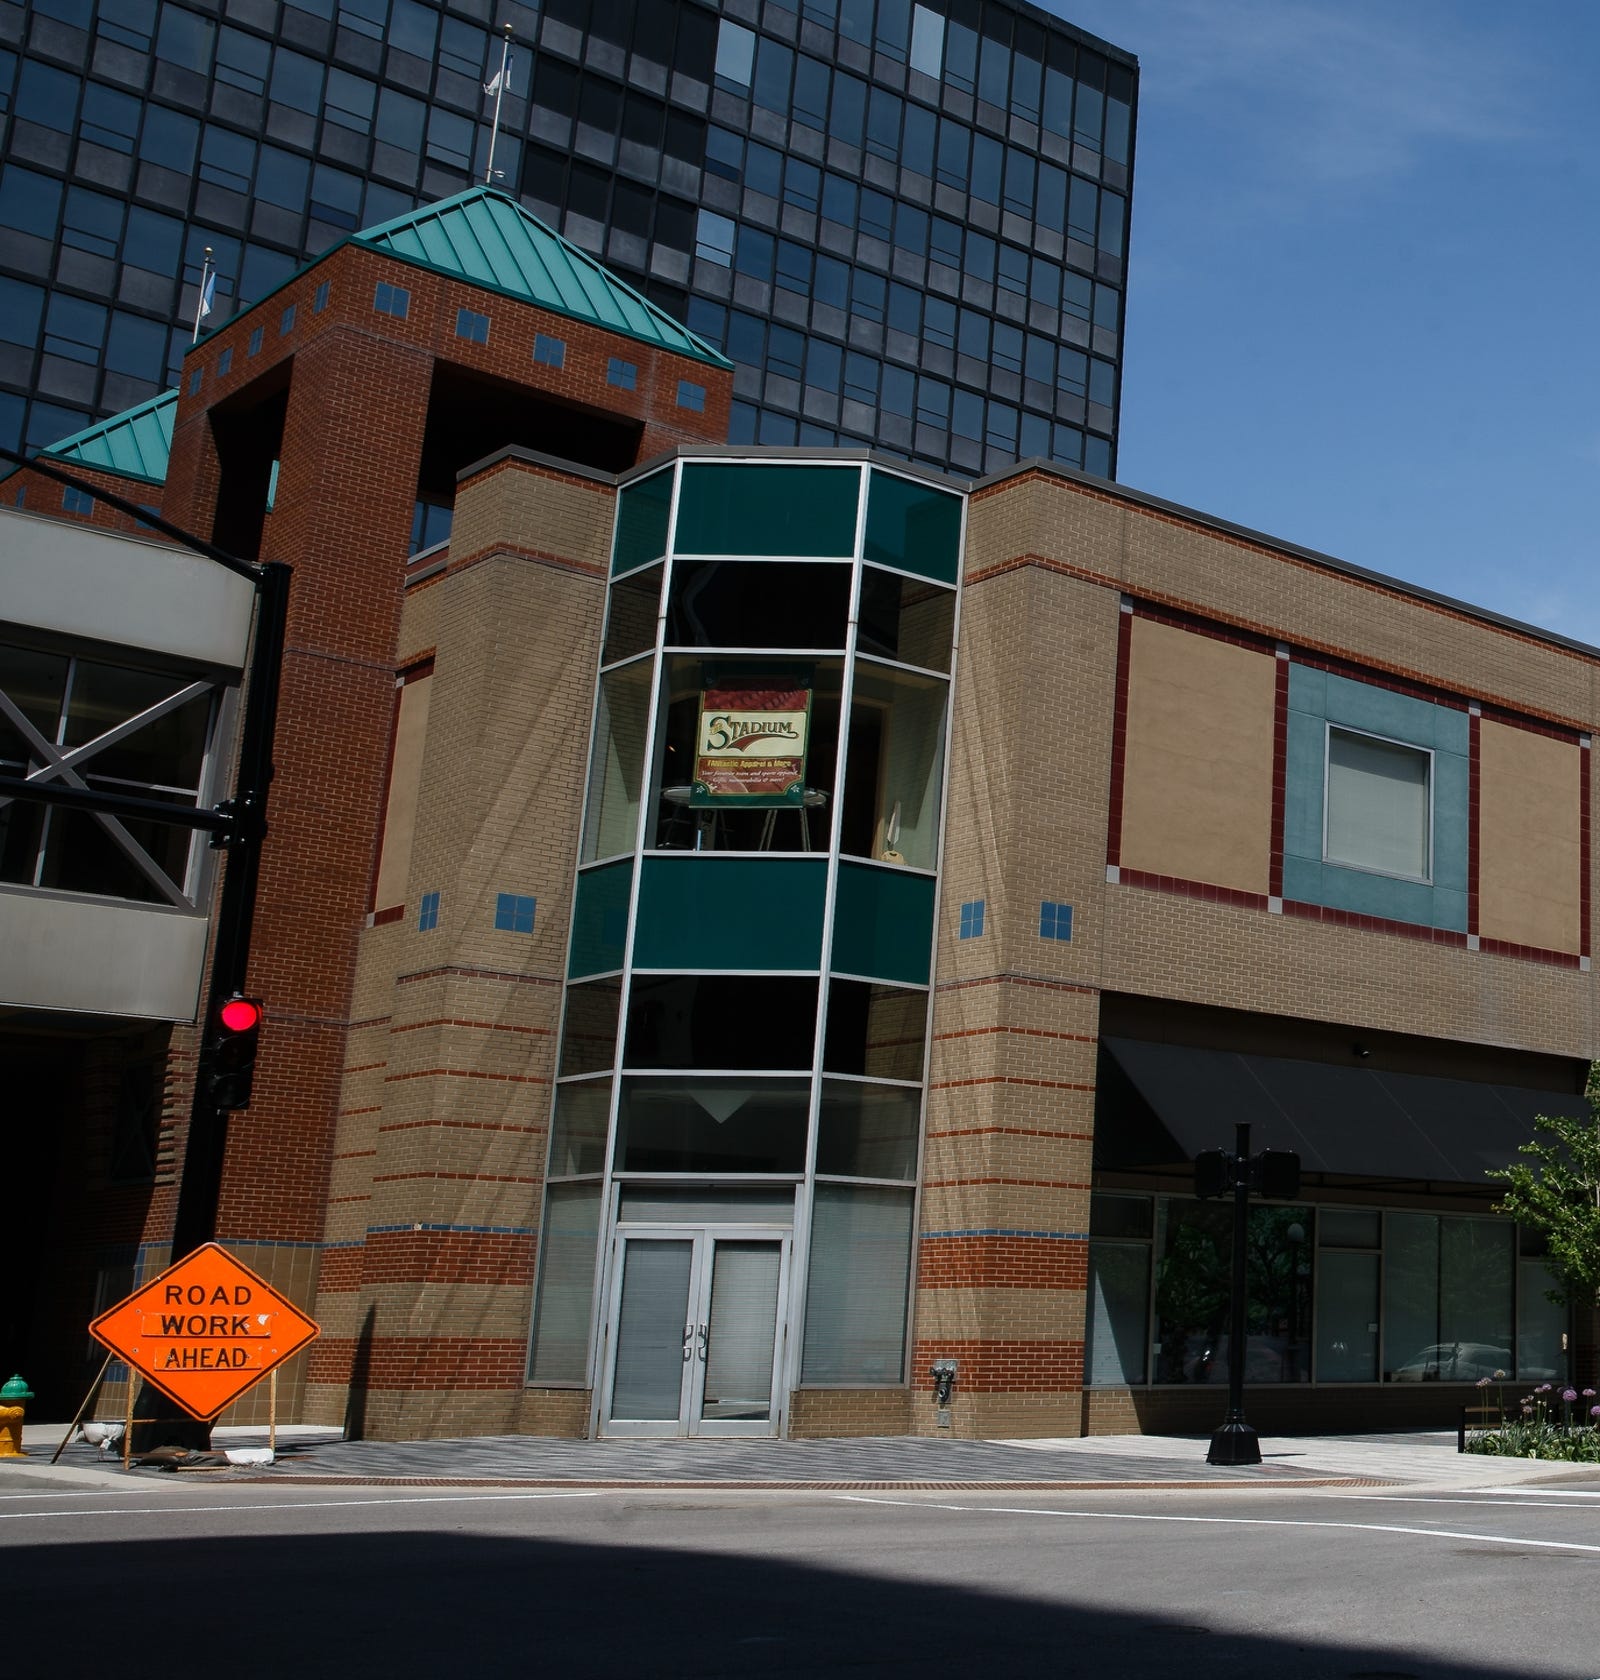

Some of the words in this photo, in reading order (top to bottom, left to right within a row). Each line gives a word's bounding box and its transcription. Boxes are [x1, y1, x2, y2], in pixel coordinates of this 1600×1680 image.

[165, 1285, 252, 1306] ROAD
[161, 1314, 251, 1336] WORK
[165, 1348, 248, 1368] AHEAD
